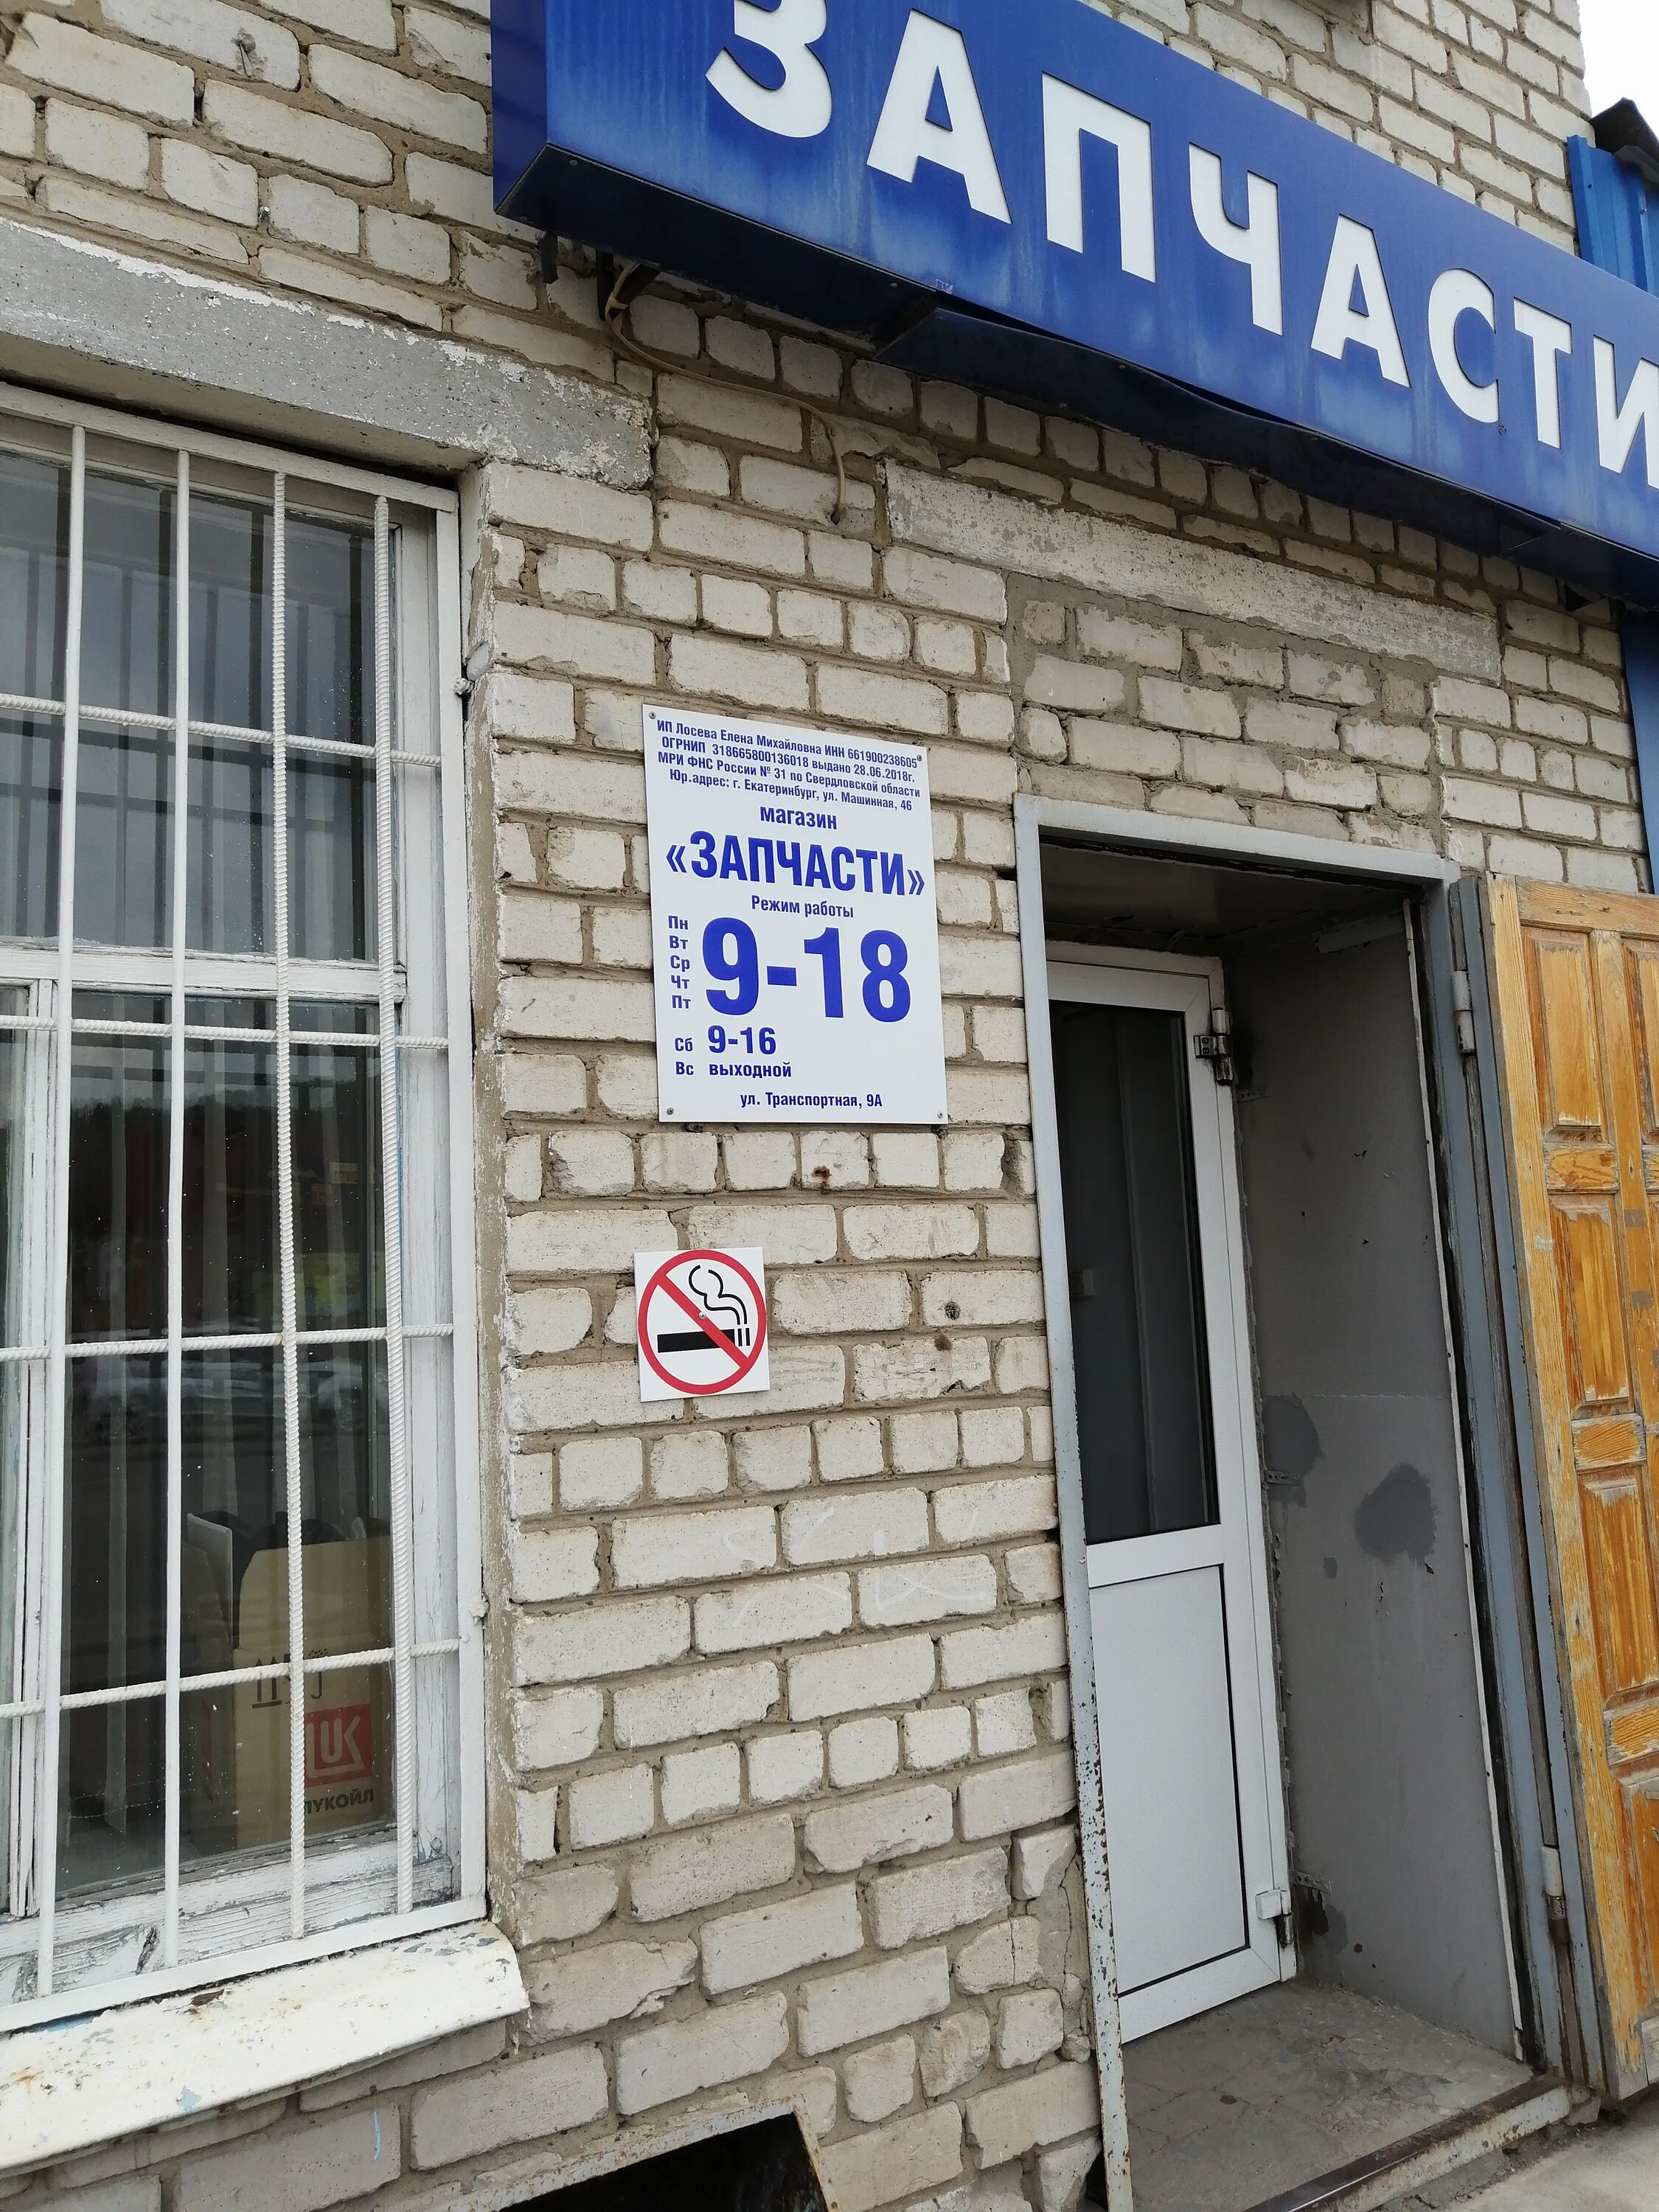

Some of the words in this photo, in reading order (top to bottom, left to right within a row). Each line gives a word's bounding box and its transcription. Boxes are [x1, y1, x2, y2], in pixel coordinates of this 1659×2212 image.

[707, 0, 1659, 490] ЗАПЧАСТИ
[657, 720, 672, 732] ИП
[676, 723, 717, 739] Лосева
[721, 729, 753, 745] Елена
[757, 735, 821, 754] Михайловна
[825, 745, 844, 758] ИНН
[848, 748, 917, 768] 661900238605
[662, 737, 705, 753] ОГРНИП
[712, 743, 809, 767] 318665800136018
[813, 761, 850, 773] выдано
[854, 764, 916, 783] 28.06.2018г.
[658, 751, 684, 765] МРИ
[687, 756, 712, 769] ФНС
[717, 761, 757, 776] России
[759, 765, 771, 777] №
[774, 769, 786, 779] 31
[790, 773, 802, 783] по
[806, 772, 877, 791] Свердловской
[670, 768, 730, 787] Юр.адрес:
[732, 780, 740, 789] г.
[745, 779, 819, 800] Екатеринбург,
[882, 783, 919, 797] области
[823, 792, 838, 802] ул.
[841, 792, 897, 810] Машинная,
[901, 800, 911, 810] 46
[760, 807, 836, 830] магазин
[667, 831, 925, 895] «ЗАПЧАСТИ»
[752, 895, 799, 913] Режим
[804, 901, 853, 917] работы
[668, 916, 688, 930] Пн
[669, 936, 687, 949] Вт
[671, 956, 689, 972] Ср
[703, 917, 910, 1022] 9-18
[671, 975, 689, 989] Чт
[672, 995, 690, 1009] Пт
[675, 1038, 692, 1051] Сб
[708, 1026, 776, 1054] 9-16
[676, 1062, 694, 1075] Вс
[709, 1062, 791, 1078] выходной
[740, 1095, 760, 1107] ул.
[765, 1092, 861, 1109] Транспортная,
[867, 1094, 882, 1107] 9А
